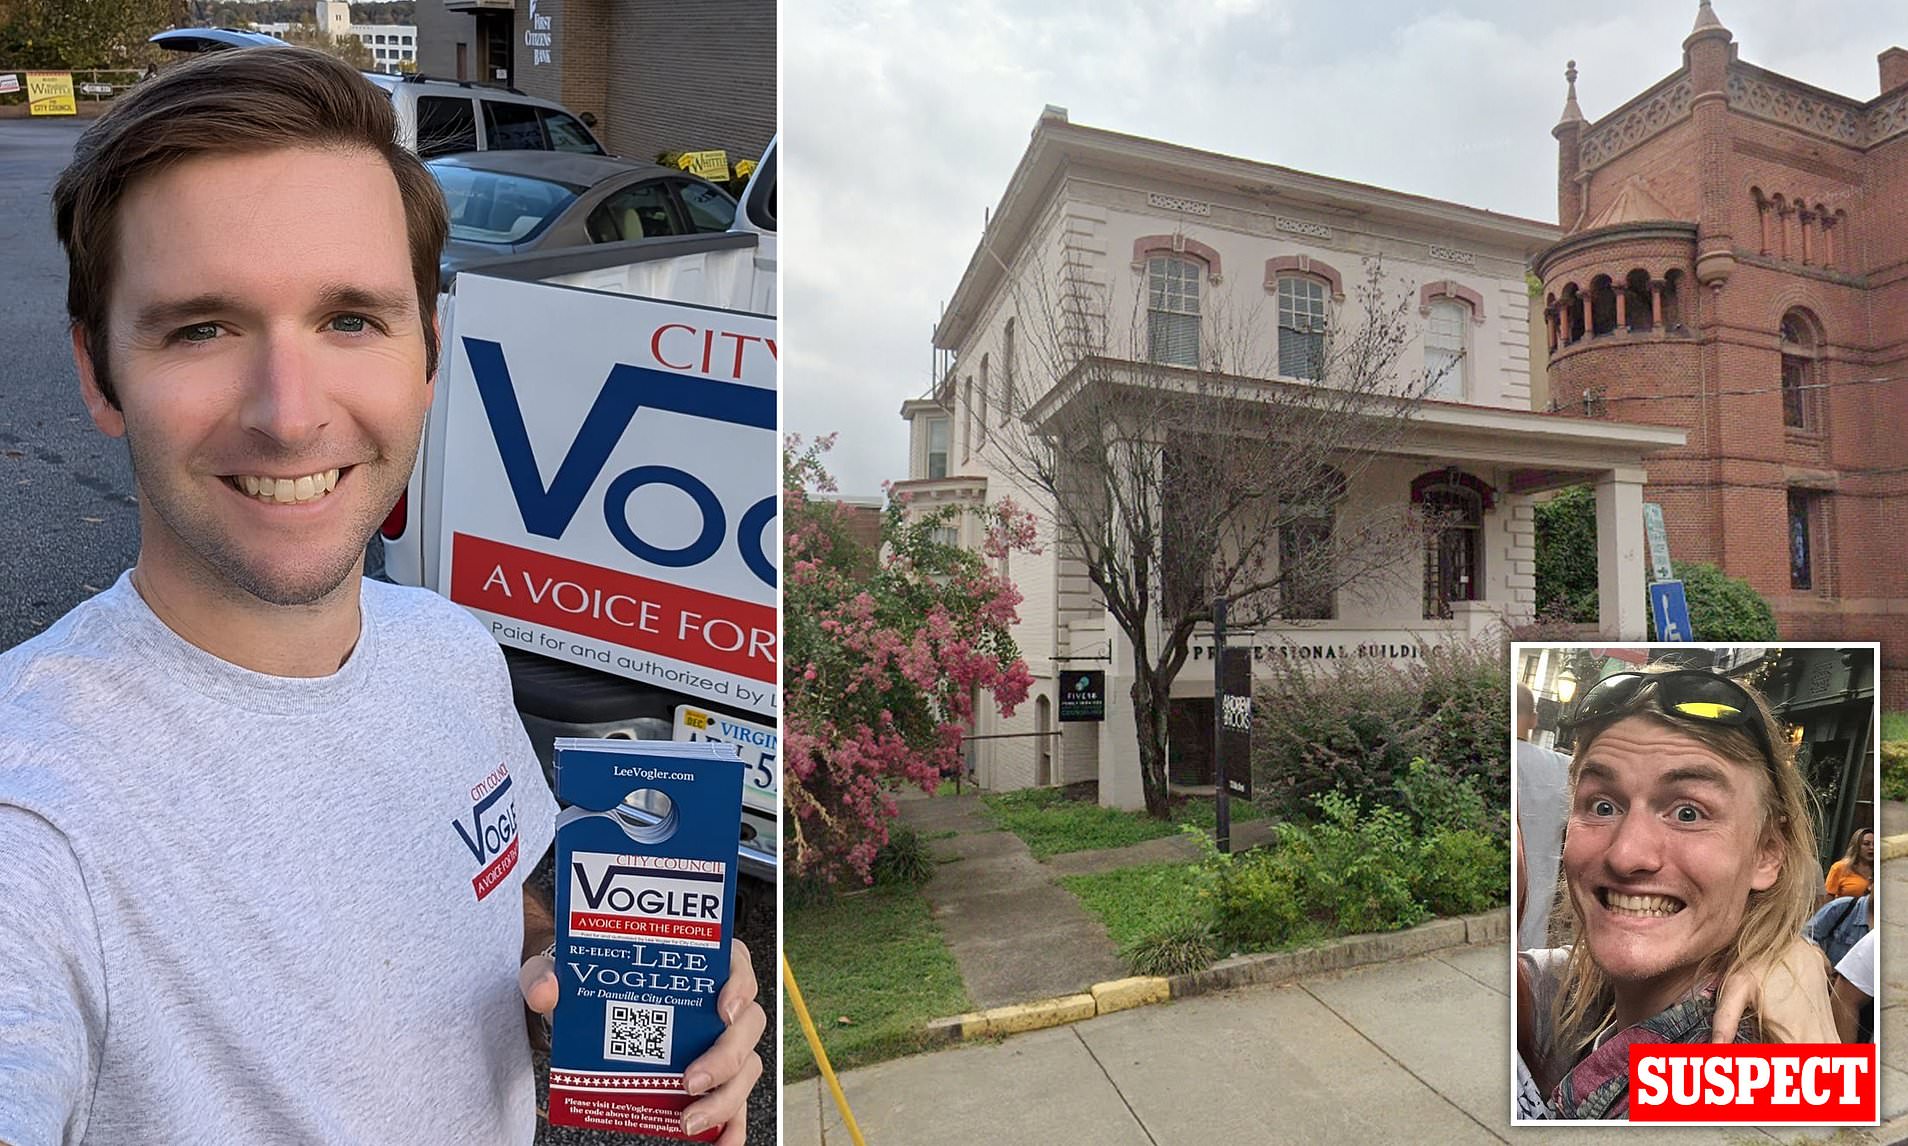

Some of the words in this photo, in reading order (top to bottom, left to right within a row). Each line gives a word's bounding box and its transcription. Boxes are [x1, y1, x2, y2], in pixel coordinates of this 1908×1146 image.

[533, 49, 552, 66] BANK
[482, 564, 513, 598] A
[522, 571, 661, 634] VOICE
[678, 610, 777, 662] FOR
[1193, 645, 1347, 660] PRESSIONAL
[1358, 644, 1443, 660] BUILDIG
[492, 620, 534, 645] Paid
[539, 630, 565, 652] for
[570, 638, 611, 666] and
[616, 650, 729, 696] authorized
[736, 676, 765, 707] by
[686, 716, 704, 729] DEC
[613, 765, 695, 782] LeeVogler.com
[470, 782, 489, 801] CITY
[616, 854, 649, 868] CITY
[654, 857, 721, 873] COUNCIL
[478, 881, 485, 894] A
[484, 864, 503, 889] VOICE
[572, 862, 724, 920] VOGLER
[578, 917, 587, 927] A
[588, 918, 622, 930] VOICE
[624, 920, 647, 932] FOR
[649, 922, 670, 934] THE
[673, 924, 713, 937] PEOPLE
[570, 945, 631, 960] RE-ELECT:
[632, 944, 709, 972] LEE
[567, 962, 716, 994] VOGLER
[577, 987, 595, 997] For
[597, 989, 640, 1001] Danville
[641, 993, 662, 1005] City
[664, 995, 704, 1007] Council
[565, 1097, 591, 1107] Please
[592, 1100, 610, 1109] visit
[611, 1103, 673, 1115] LeeVogler.com
[570, 1106, 583, 1114] the
[585, 1108, 604, 1116] code
[605, 1110, 630, 1119] above
[631, 1112, 640, 1120] to
[641, 1114, 664, 1123] learn
[584, 1115, 613, 1126] donate
[615, 1118, 623, 1127] to
[624, 1119, 638, 1128] the
[639, 1121, 682, 1134] campaign.
